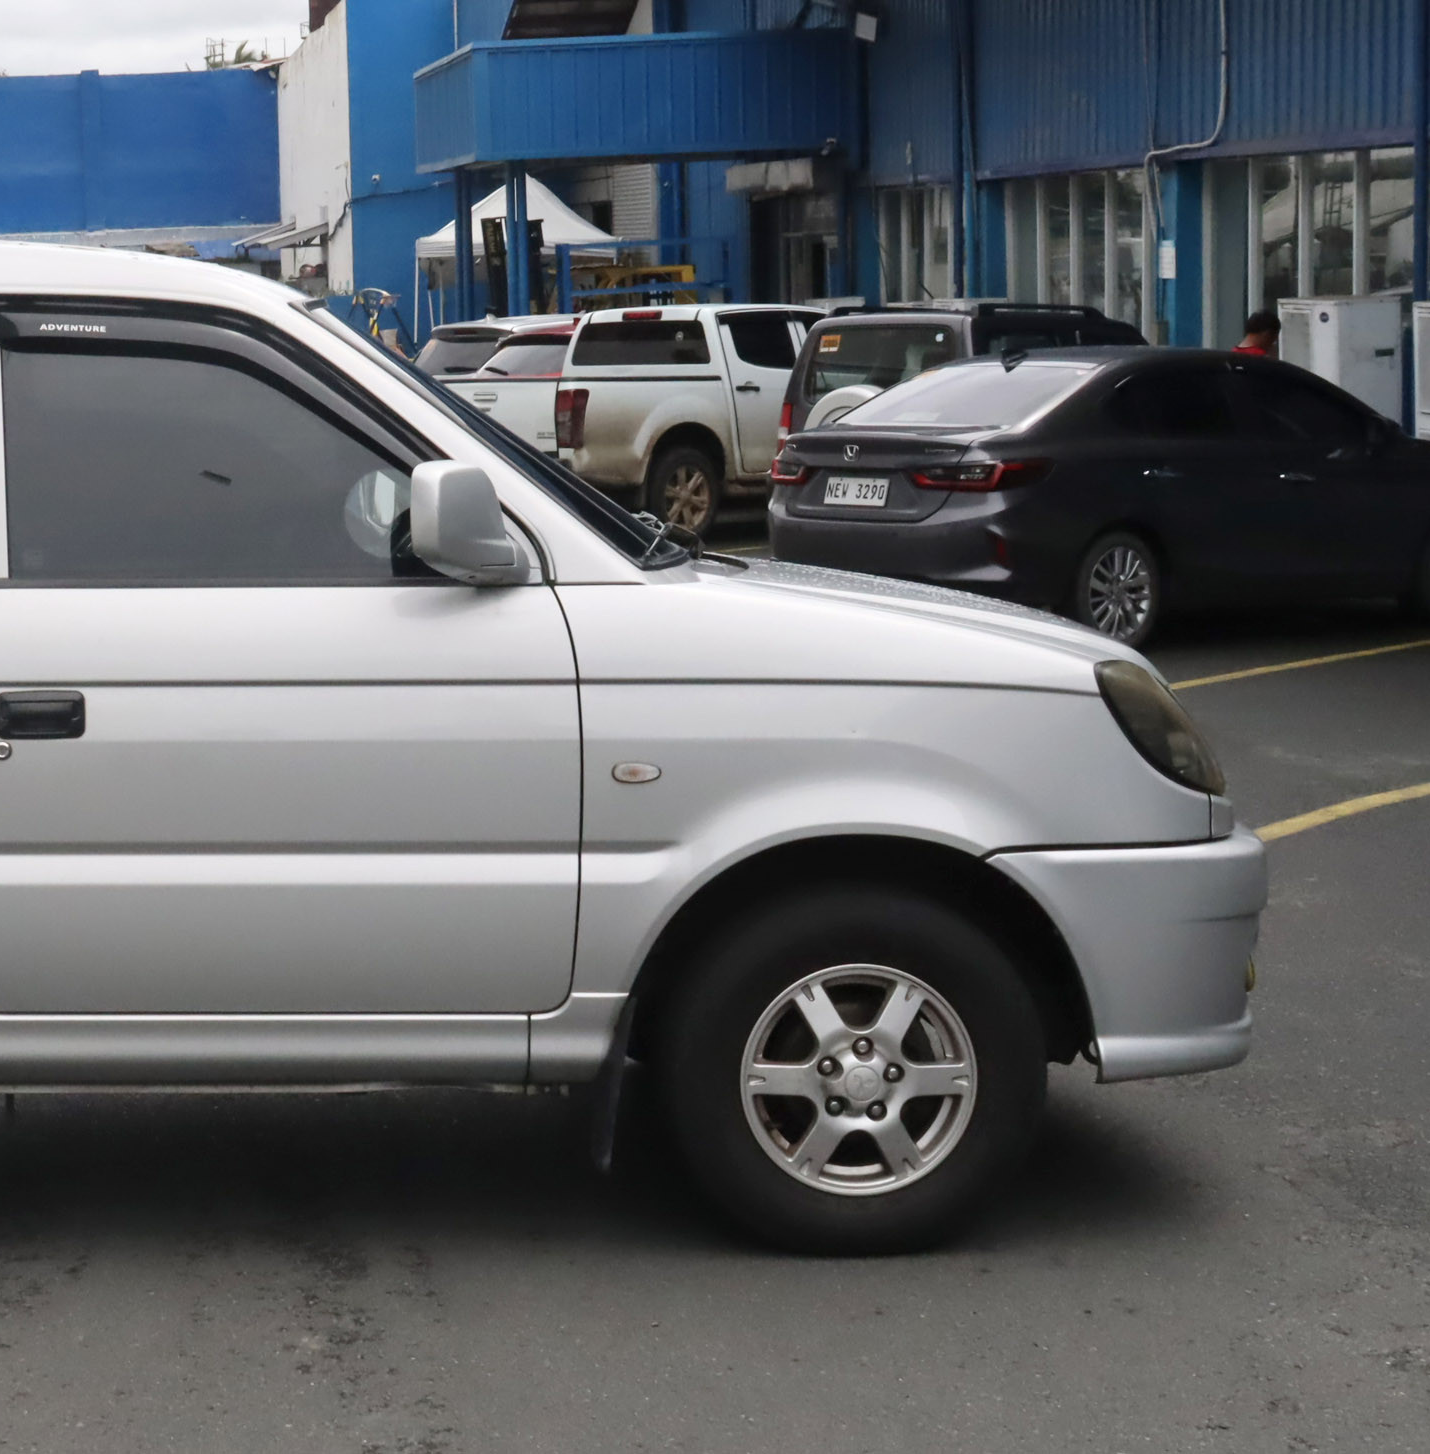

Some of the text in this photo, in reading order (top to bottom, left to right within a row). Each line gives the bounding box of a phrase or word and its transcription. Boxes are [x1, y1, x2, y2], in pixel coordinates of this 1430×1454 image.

[39, 323, 107, 333] ADVENTURE
[826, 483, 885, 500] NEW 3290
